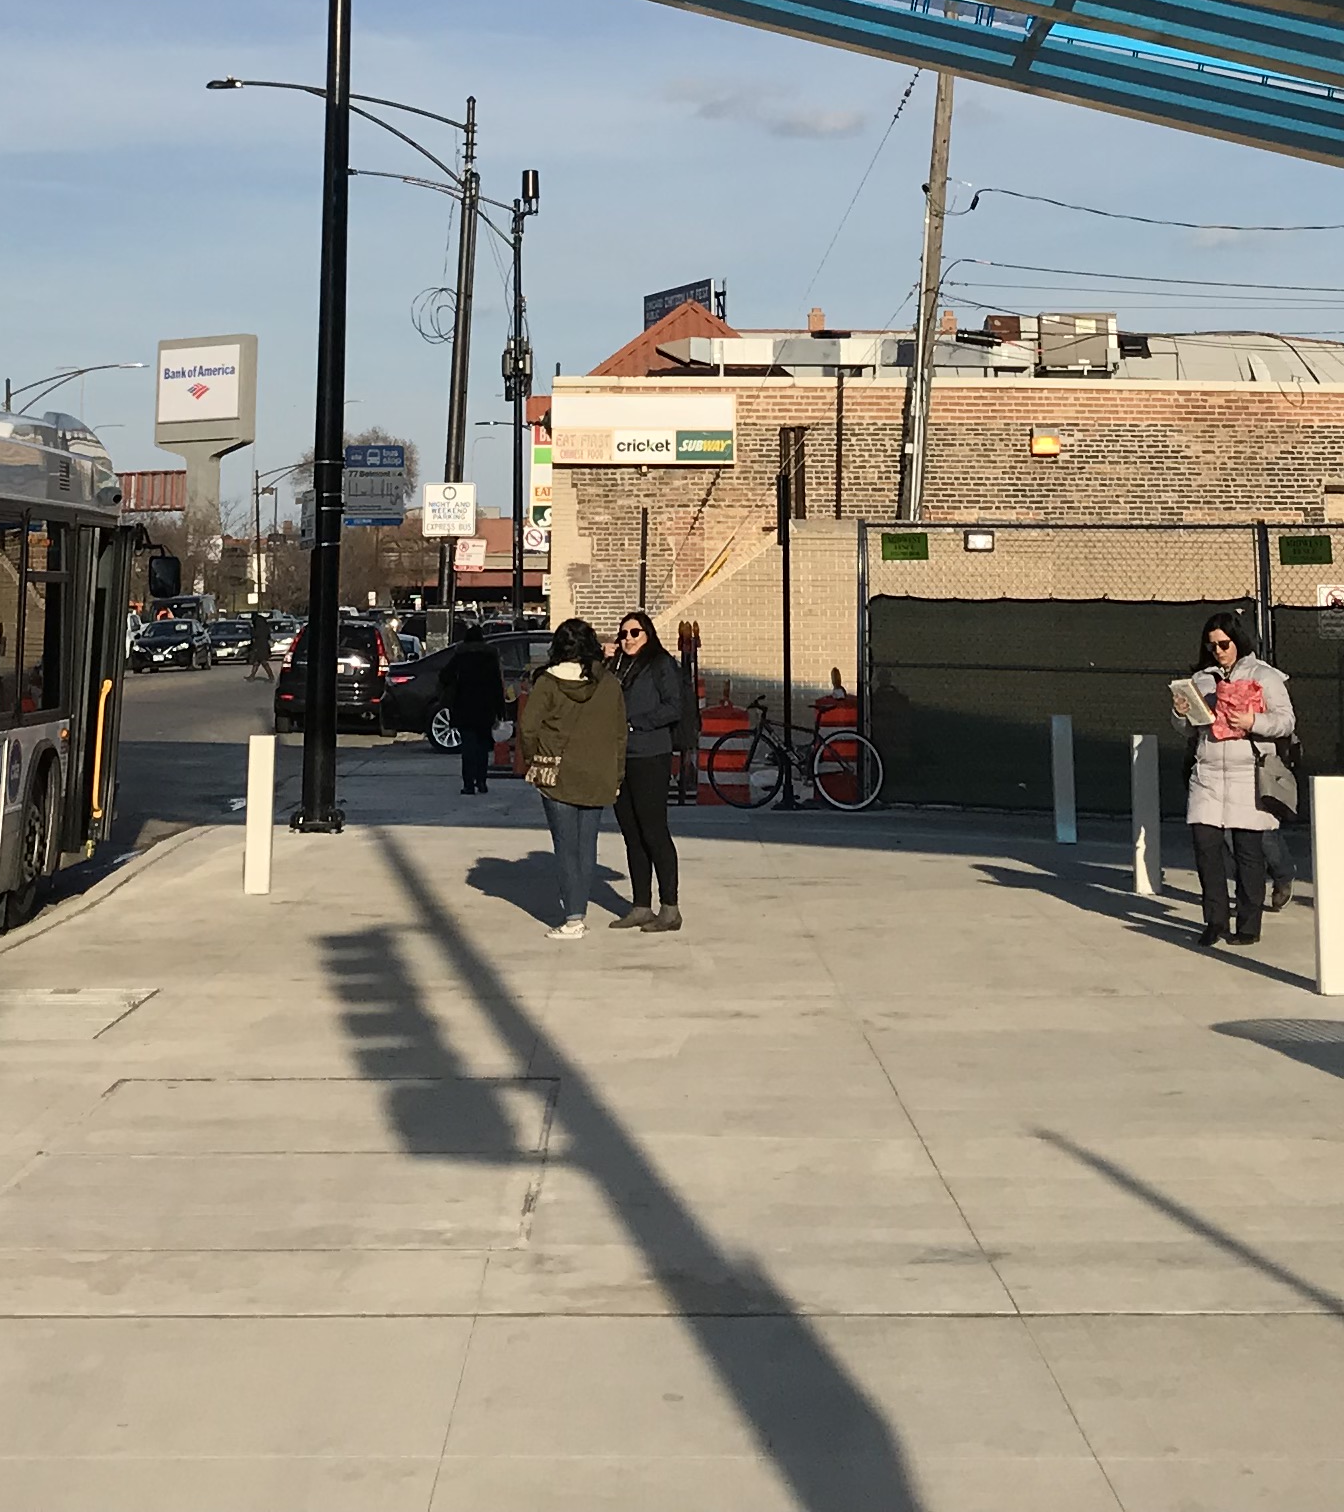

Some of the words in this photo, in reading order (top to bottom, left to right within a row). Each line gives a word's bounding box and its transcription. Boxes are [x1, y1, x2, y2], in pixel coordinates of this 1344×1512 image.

[164, 367, 186, 379] Bank
[187, 366, 197, 377] of
[198, 364, 236, 377] America
[556, 433, 577, 448] EAT
[581, 433, 611, 448] FIRST
[616, 438, 671, 452] cricket
[678, 439, 733, 453] SUBWAY
[383, 449, 399, 457] bus
[383, 457, 402, 466] stop
[348, 470, 358, 478] 77
[426, 522, 456, 531] EXPRESS
[458, 522, 472, 531] BUS
